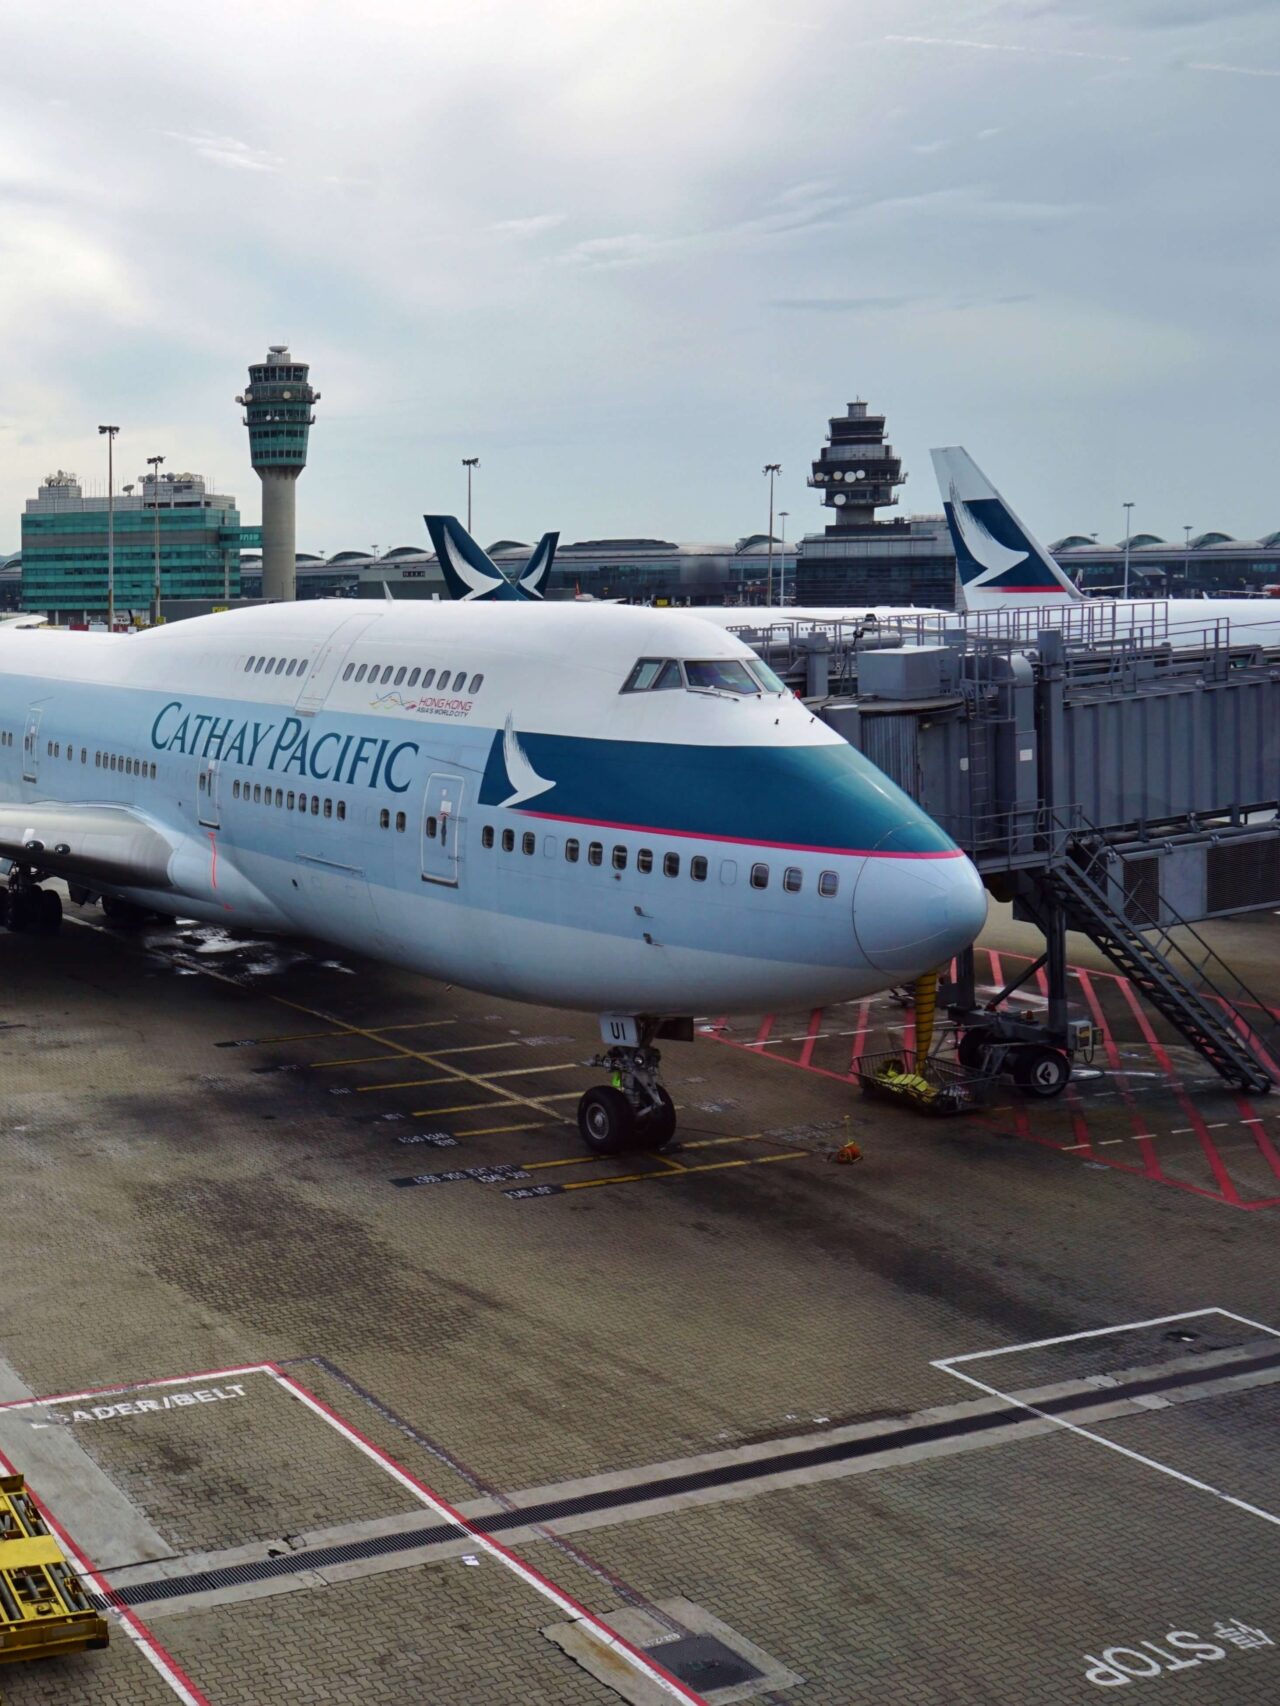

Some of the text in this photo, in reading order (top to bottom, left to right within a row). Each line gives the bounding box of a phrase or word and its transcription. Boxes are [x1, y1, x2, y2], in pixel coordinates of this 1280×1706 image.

[418, 696, 473, 711] HONG KONG
[434, 708, 454, 717] WORLD
[151, 701, 420, 793] CATHAY PACIFIC
[1083, 1630, 1226, 1686] STOP
